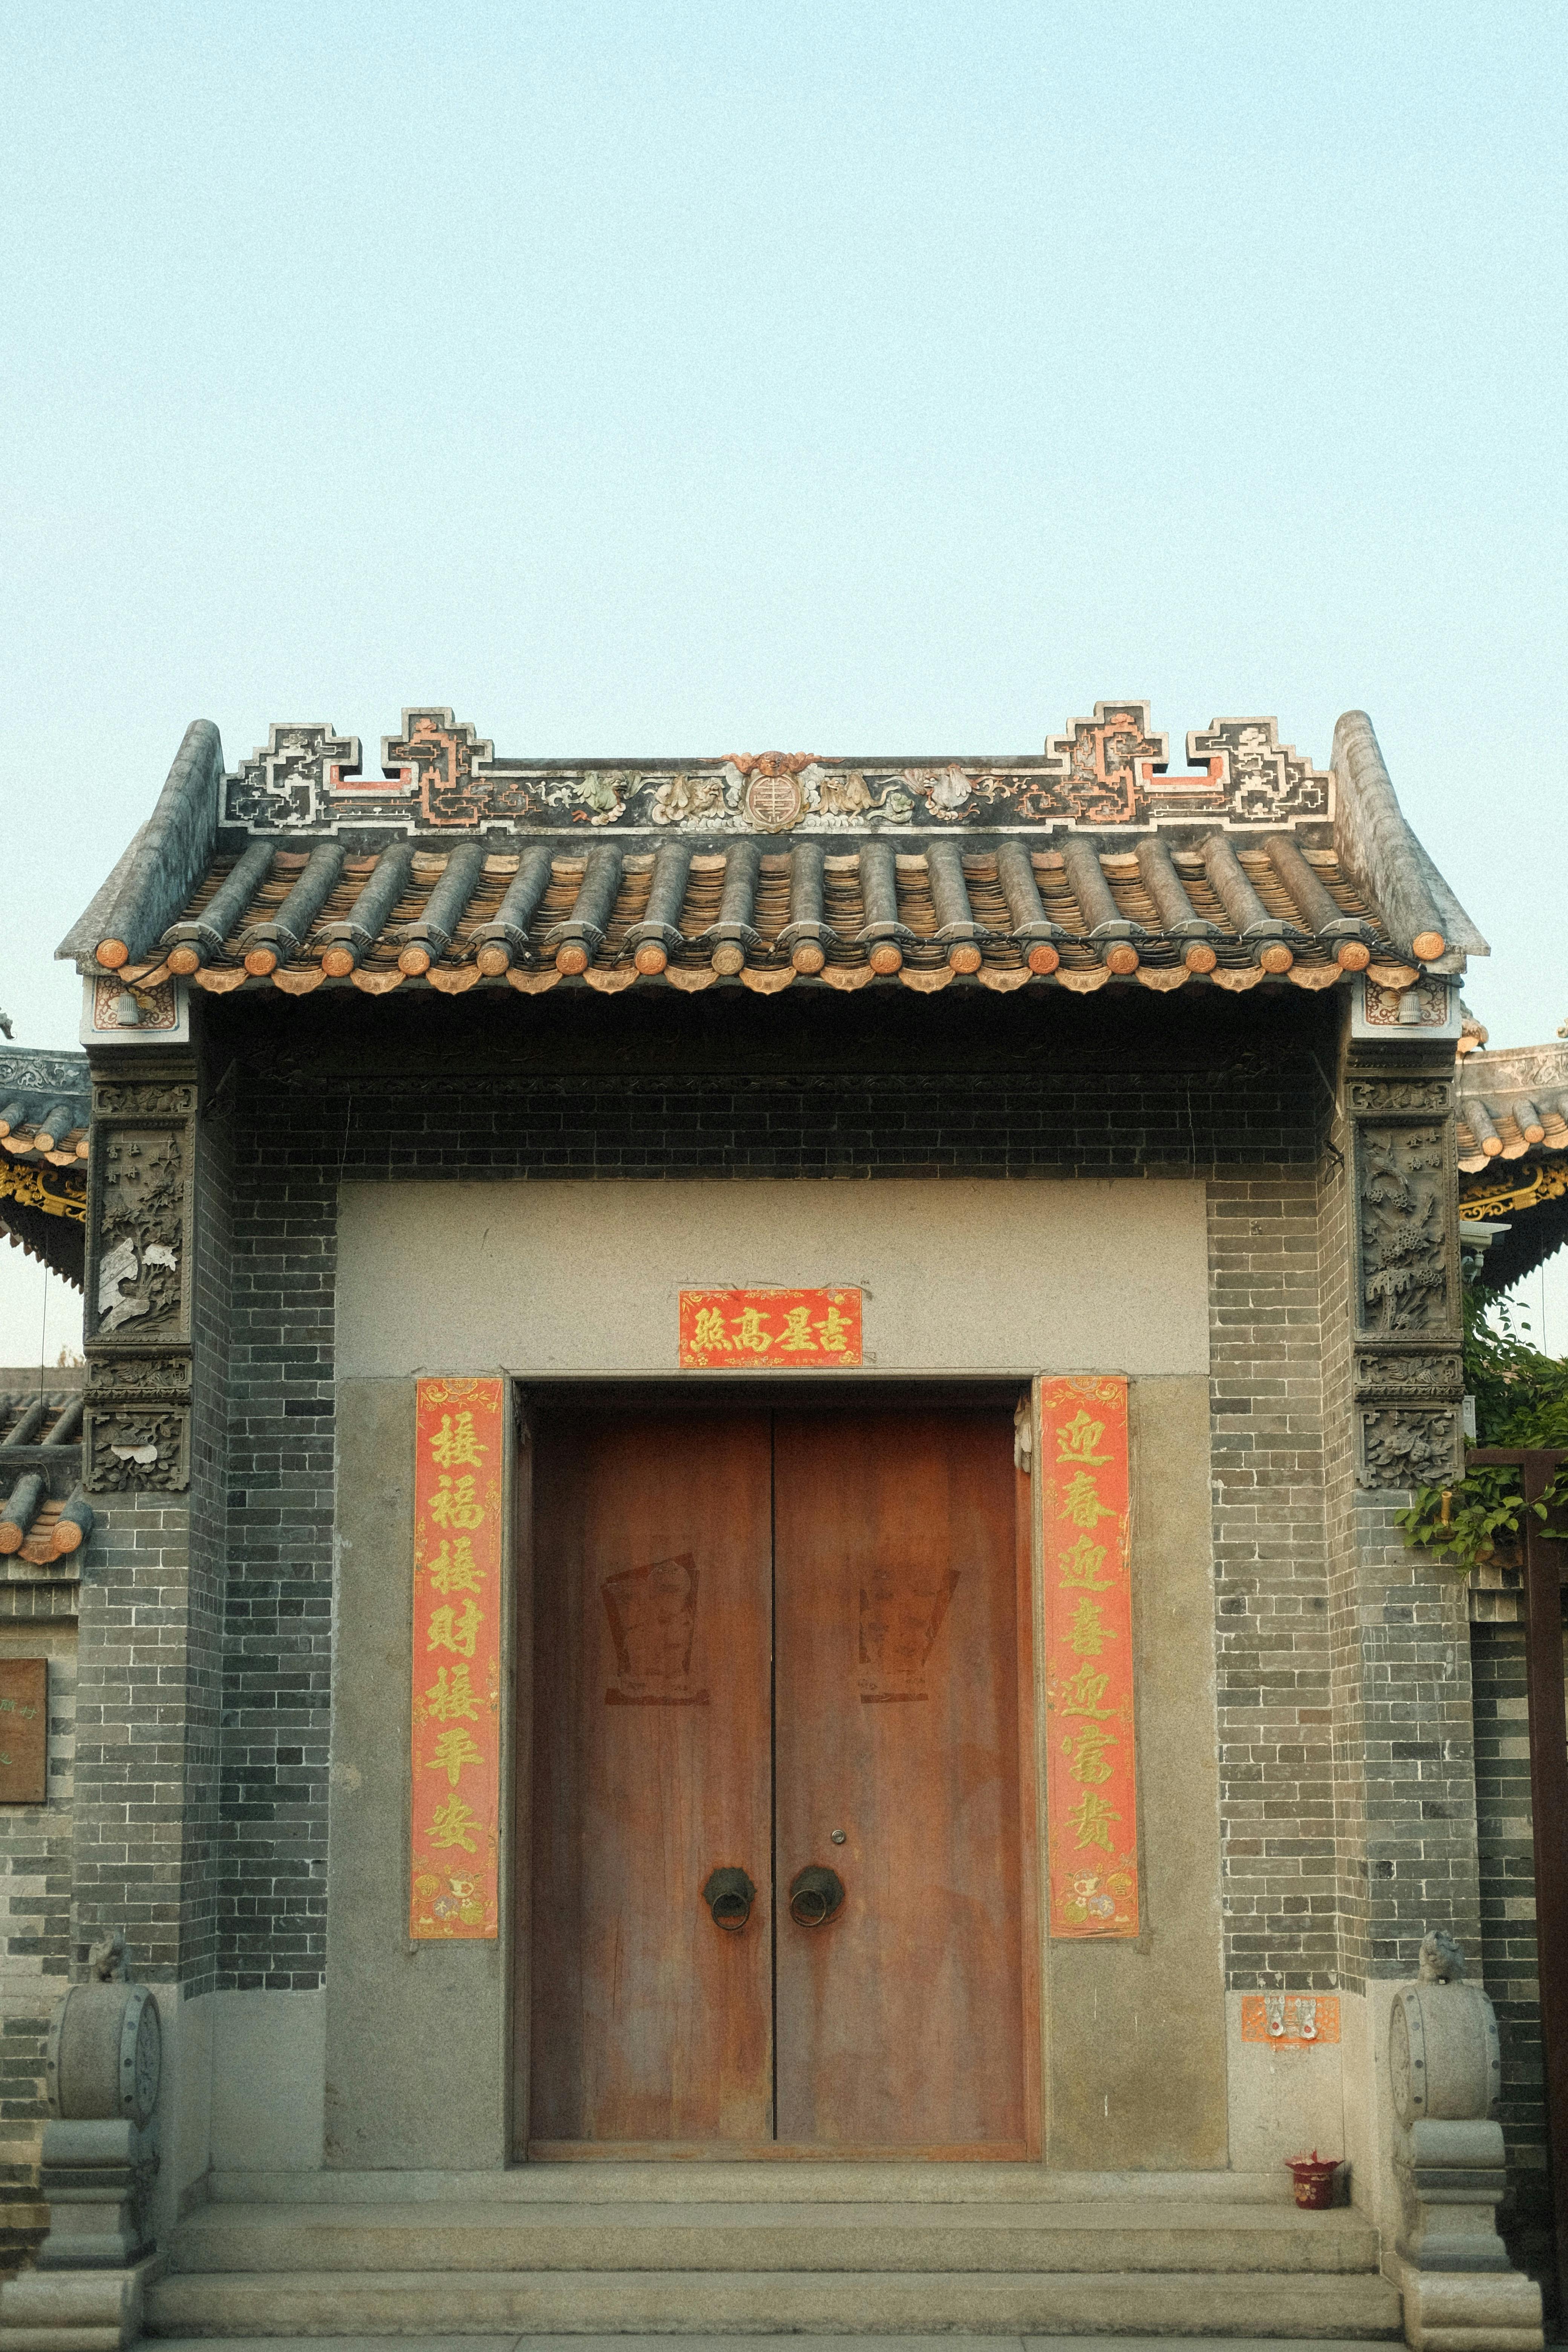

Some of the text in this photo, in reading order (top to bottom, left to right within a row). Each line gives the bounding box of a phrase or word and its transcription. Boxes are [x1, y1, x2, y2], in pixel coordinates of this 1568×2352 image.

[125, 1143, 140, 1178] 牡丹
[424, 1411, 489, 1854] 接福接財接平安
